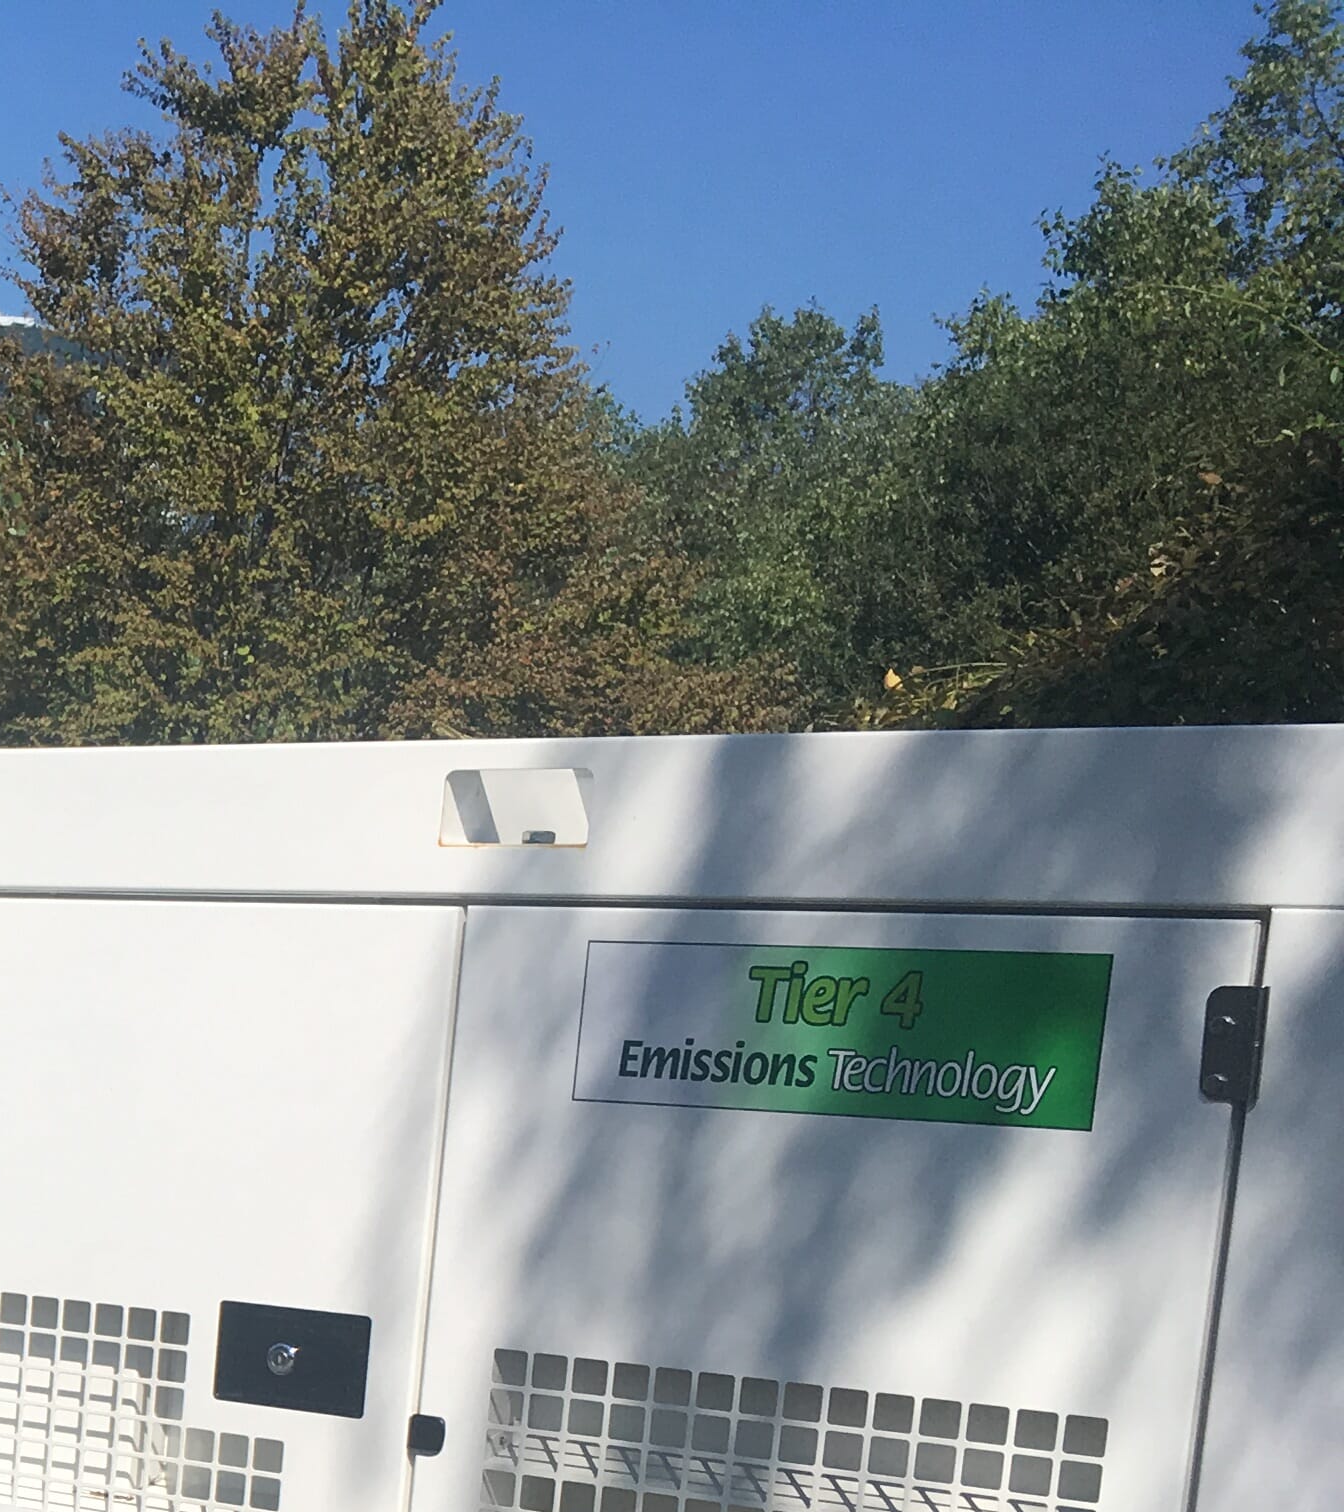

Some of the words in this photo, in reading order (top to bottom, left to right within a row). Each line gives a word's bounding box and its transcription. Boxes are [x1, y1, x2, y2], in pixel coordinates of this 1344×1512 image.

[749, 960, 869, 1026] Tier
[880, 970, 924, 1030] 4
[618, 1037, 817, 1088] Emissions
[828, 1046, 1057, 1116] Technology
